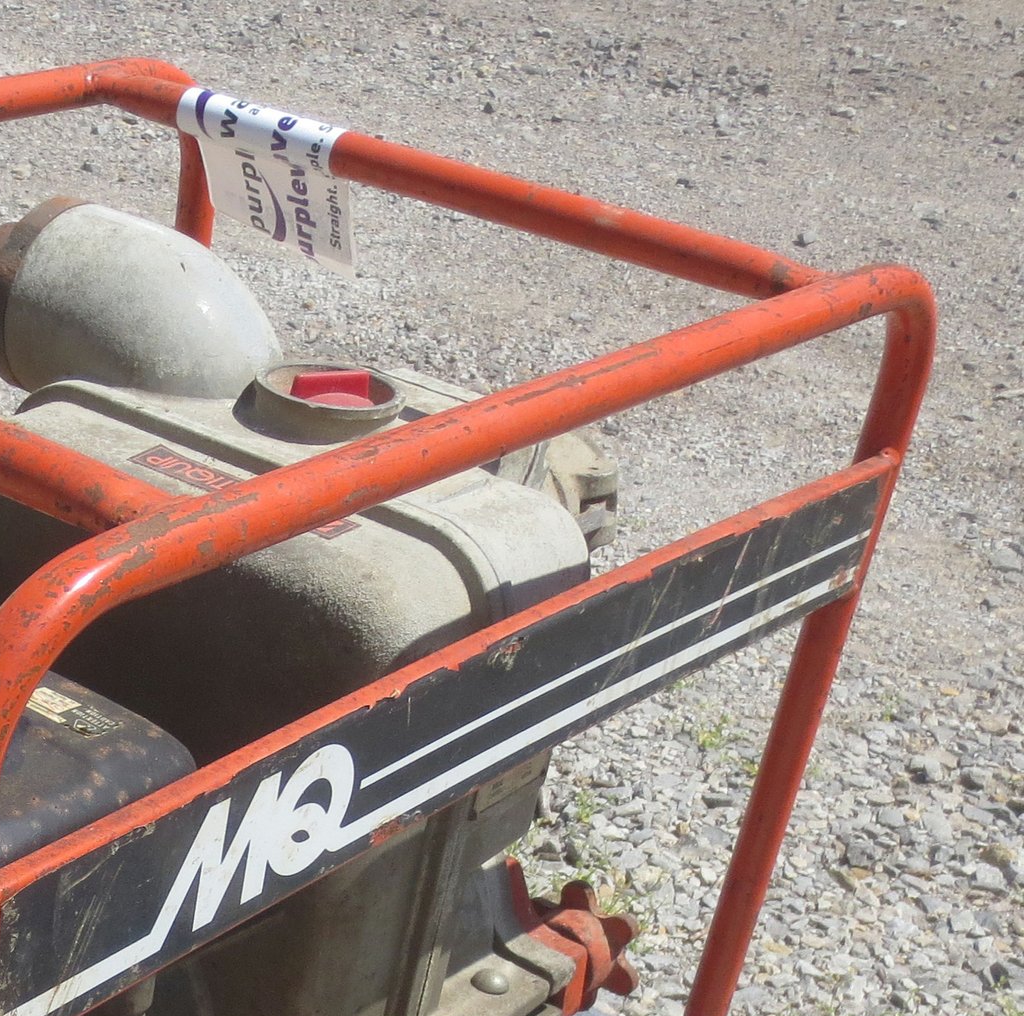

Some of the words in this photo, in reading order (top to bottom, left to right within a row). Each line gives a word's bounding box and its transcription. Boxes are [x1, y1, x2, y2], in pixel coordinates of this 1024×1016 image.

[235, 147, 271, 234] purpl
[306, 138, 324, 171] ple.
[326, 185, 342, 250] Straight.
[151, 743, 356, 951] MQ
